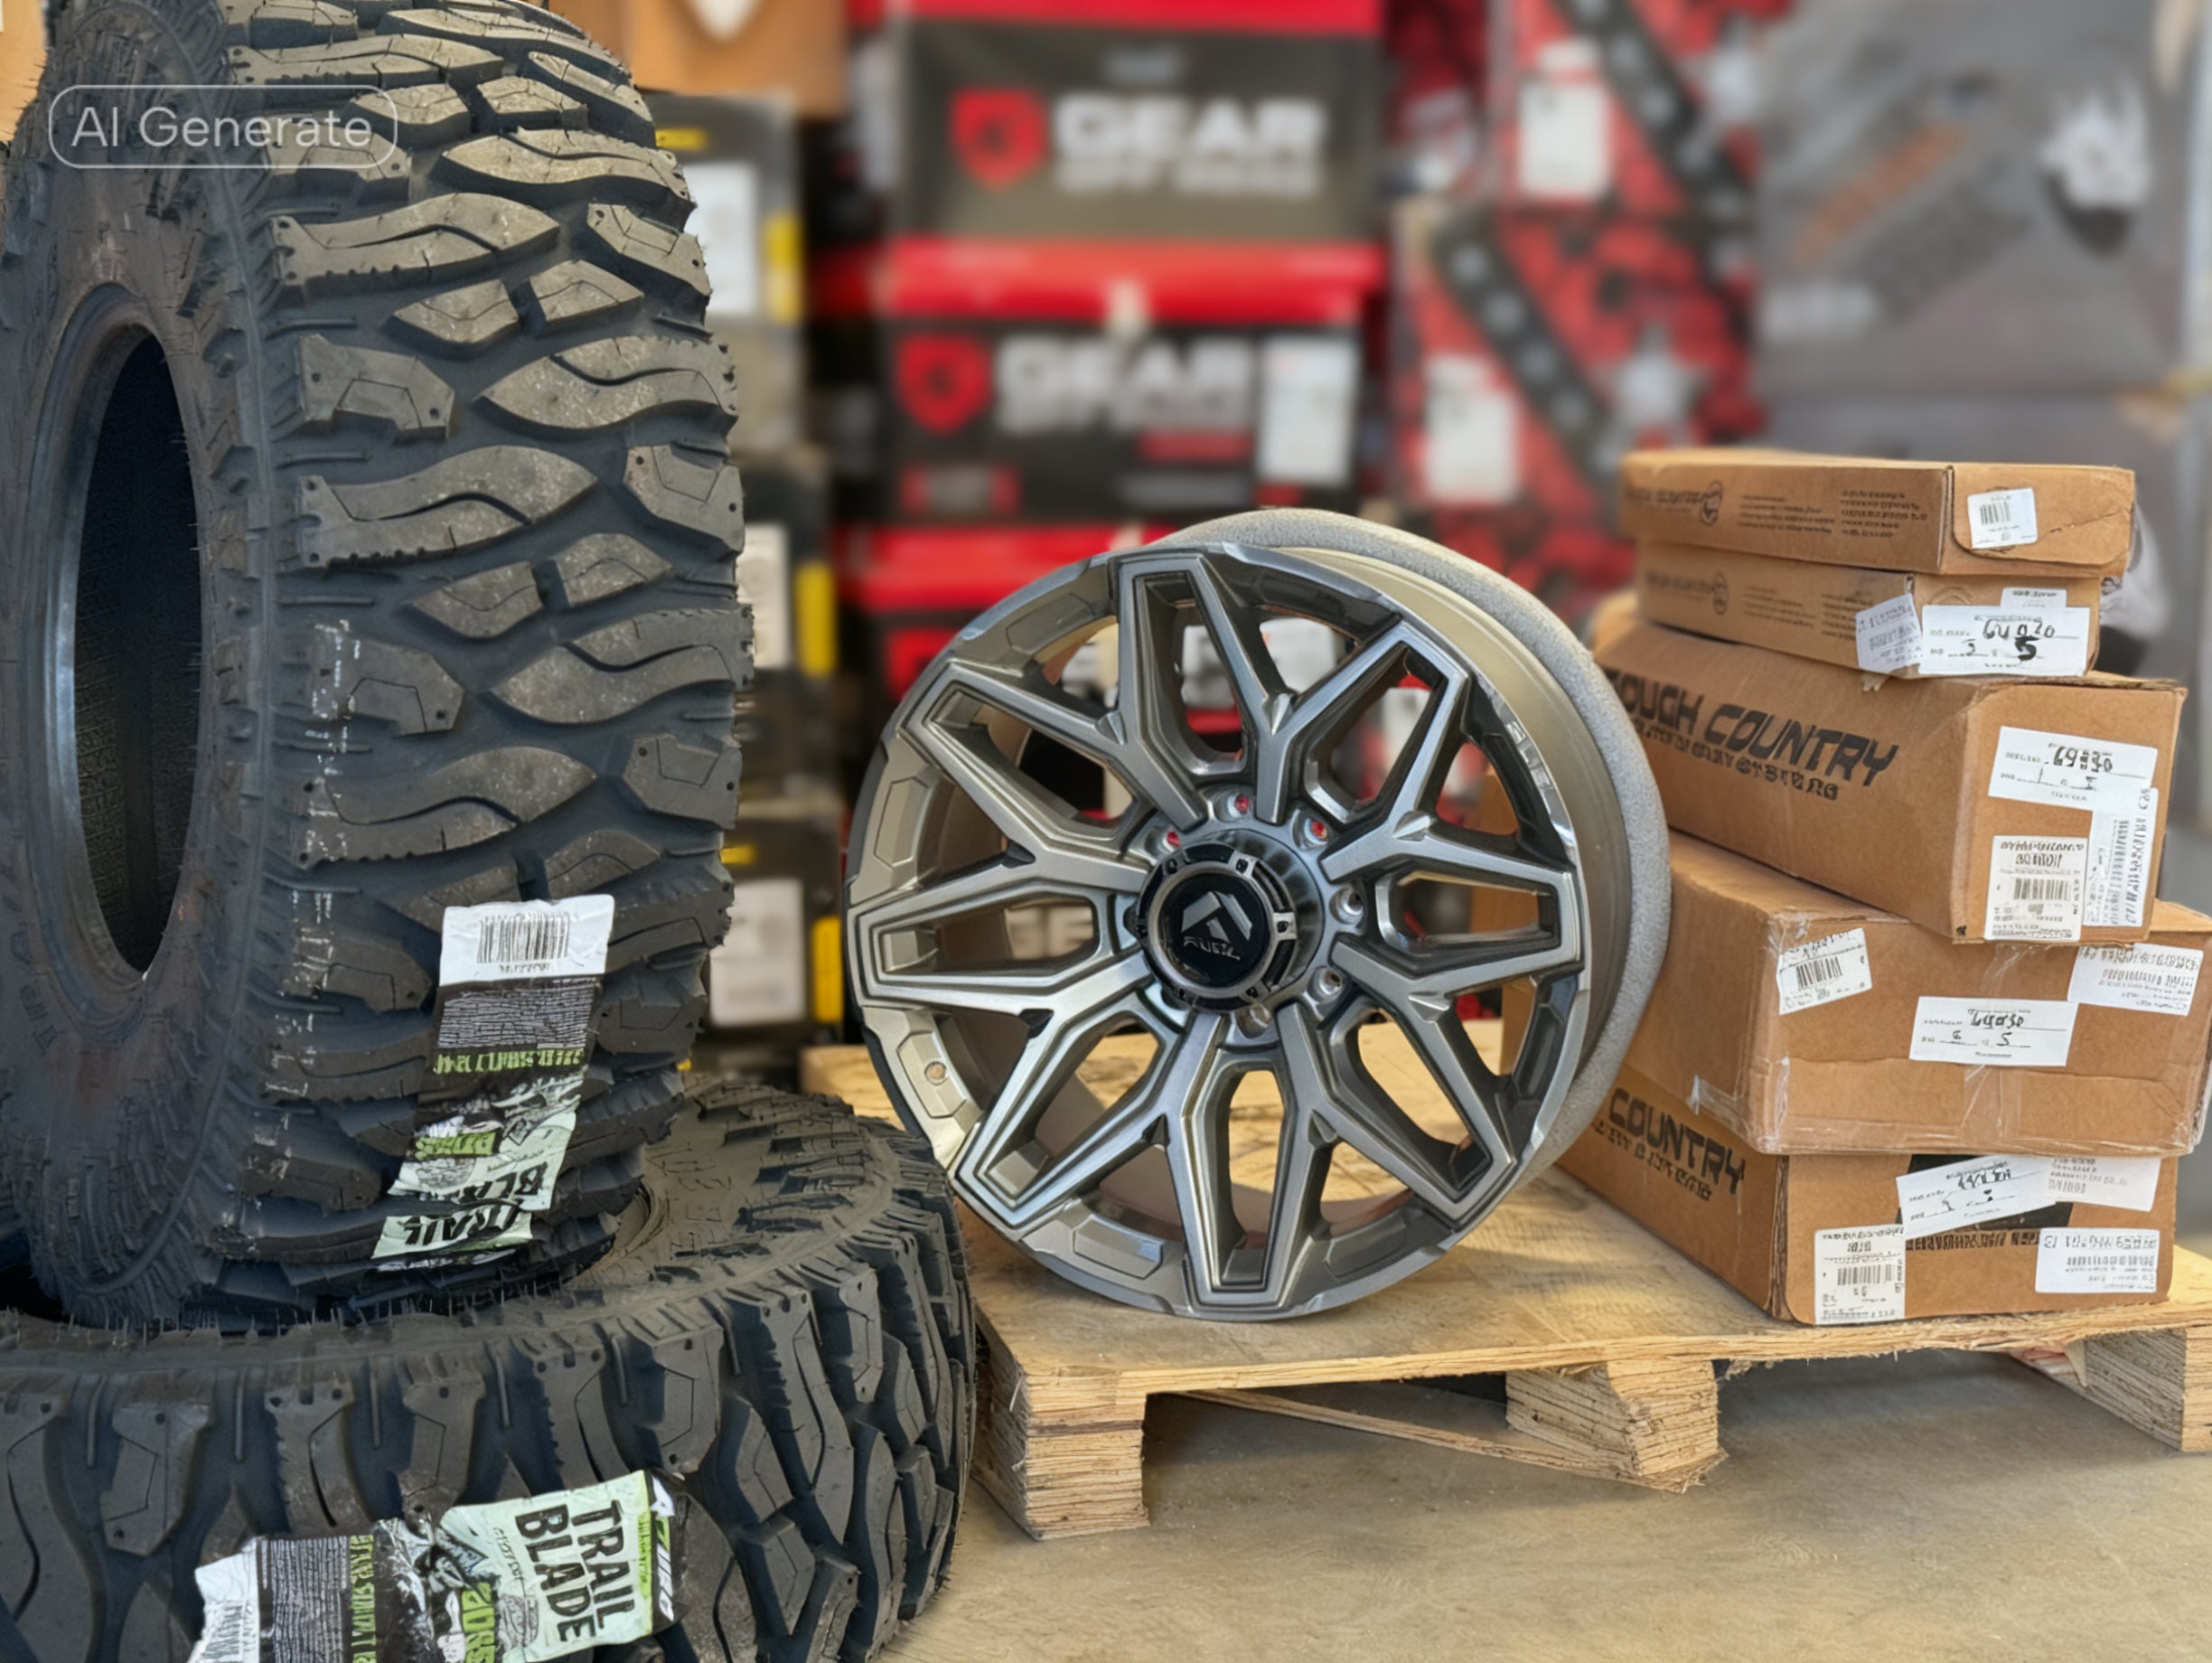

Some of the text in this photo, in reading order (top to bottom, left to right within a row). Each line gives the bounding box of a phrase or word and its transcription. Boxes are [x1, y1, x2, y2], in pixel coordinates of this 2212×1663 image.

[1605, 669, 1704, 737] OUGH
[1703, 704, 1900, 787] COUNTRY
[1609, 1087, 1746, 1195] COUNTRY
[514, 1504, 596, 1642] BLADE
[571, 1499, 635, 1630] TRAIL
